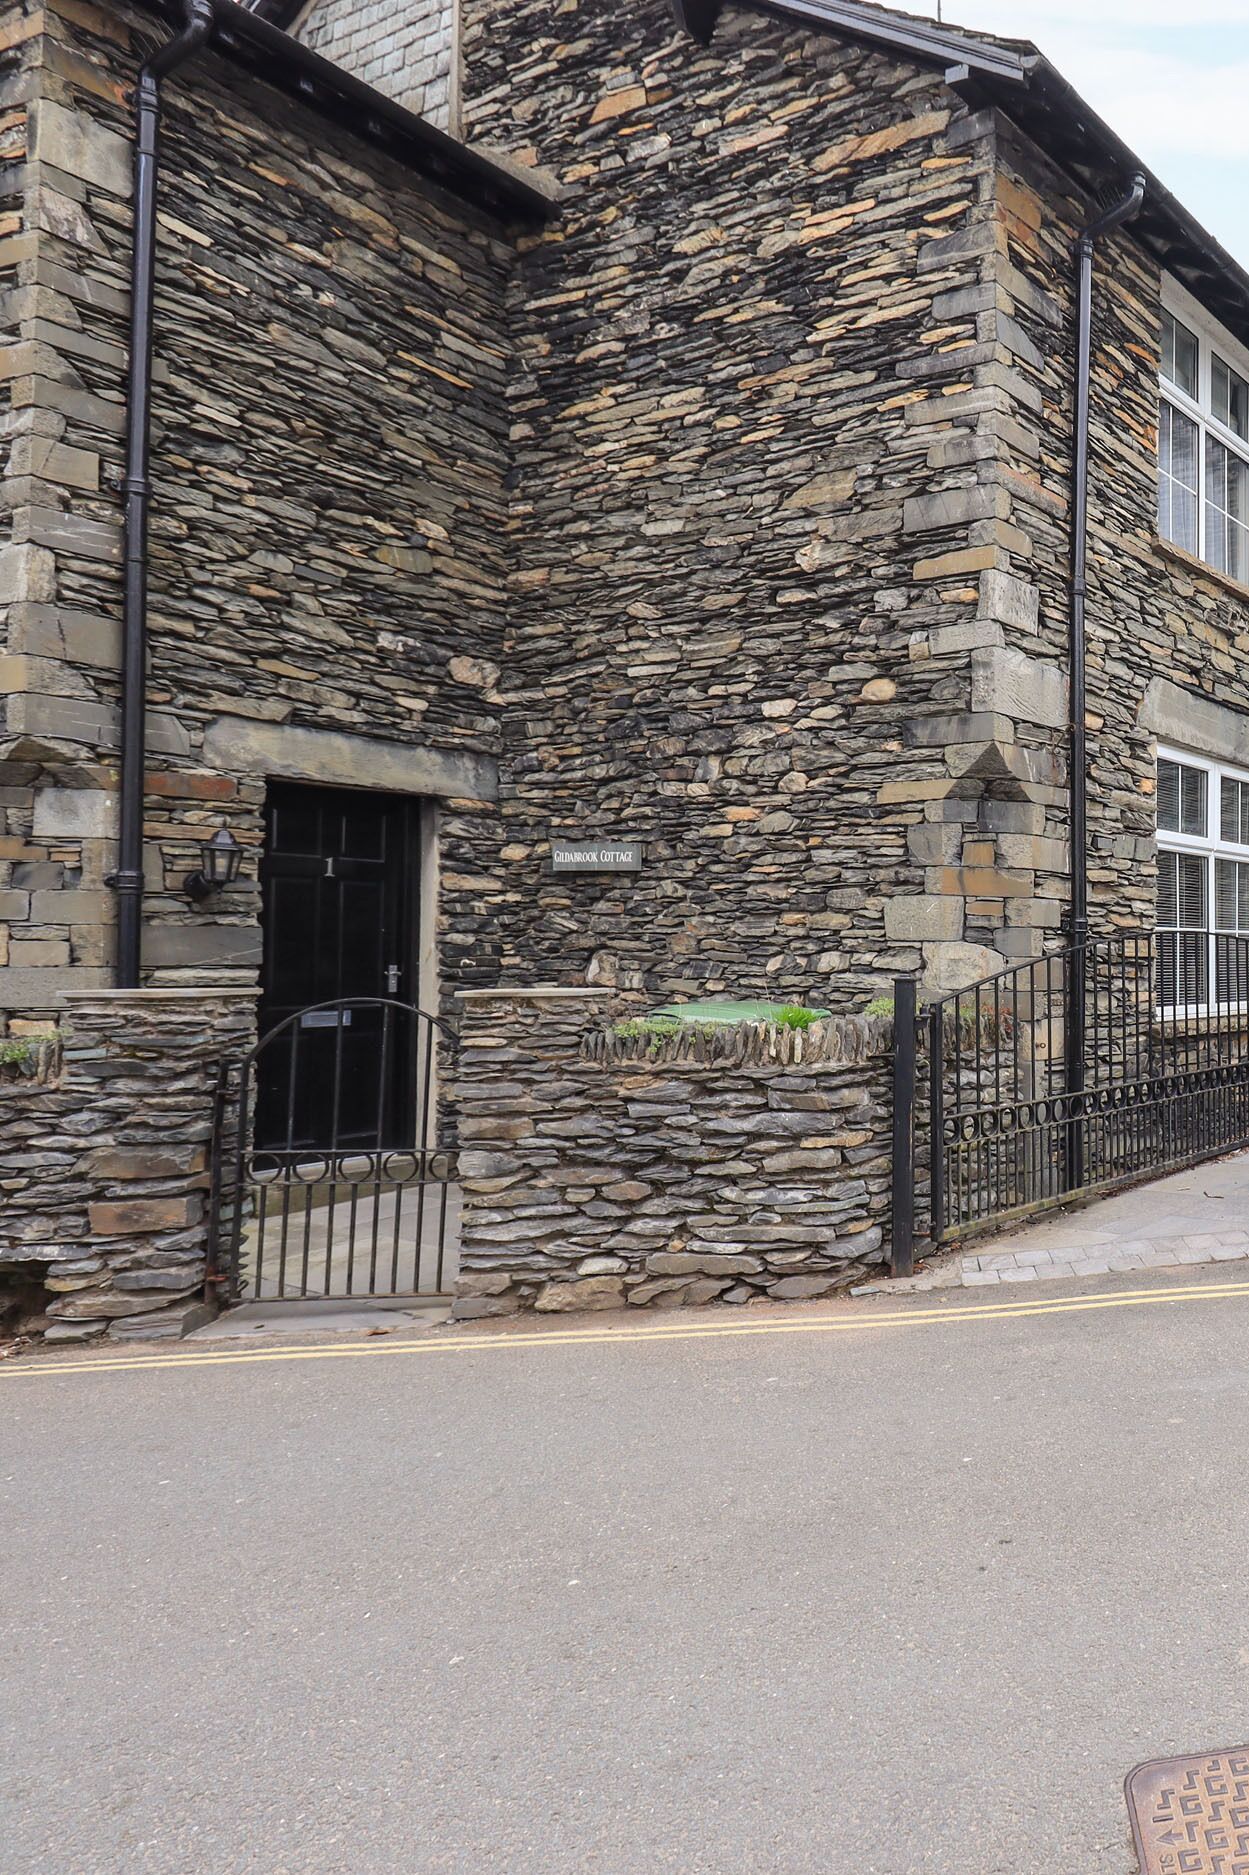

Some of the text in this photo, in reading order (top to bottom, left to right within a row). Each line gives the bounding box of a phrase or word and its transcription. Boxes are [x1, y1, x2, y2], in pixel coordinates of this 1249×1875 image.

[554, 850, 633, 862] GILDABROOK COTTAGE
[323, 857, 336, 877] 1
